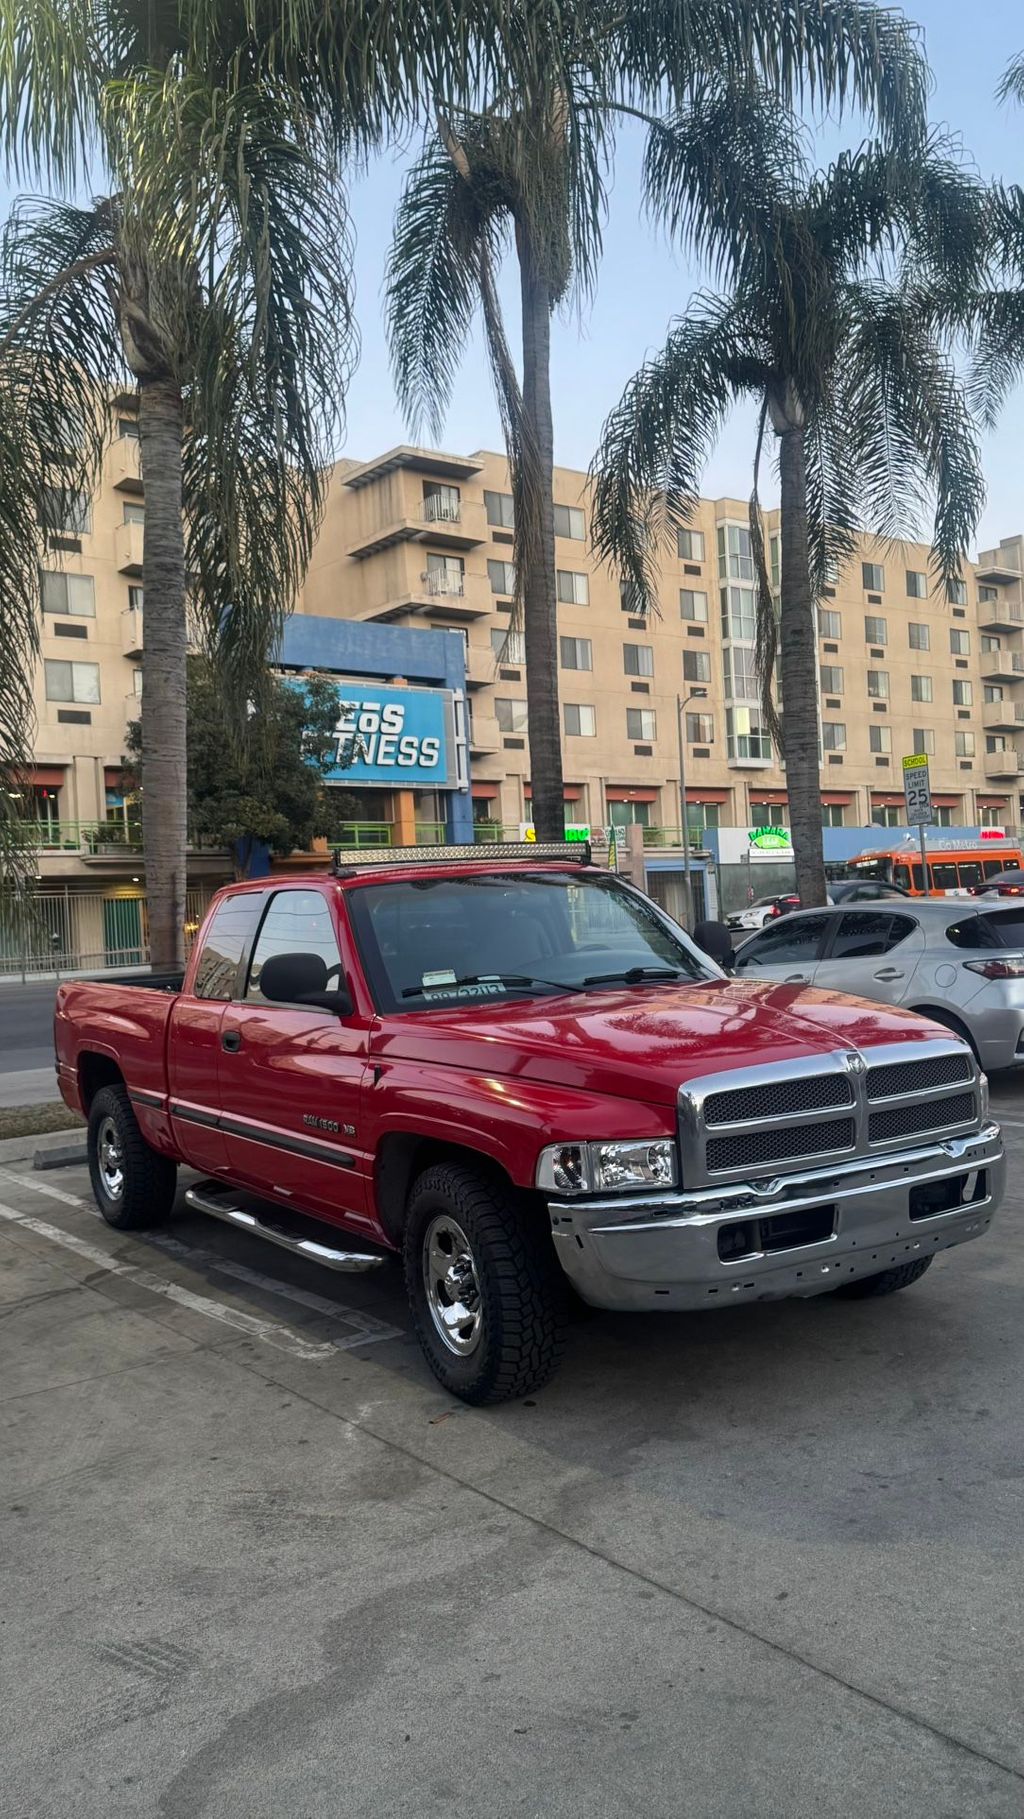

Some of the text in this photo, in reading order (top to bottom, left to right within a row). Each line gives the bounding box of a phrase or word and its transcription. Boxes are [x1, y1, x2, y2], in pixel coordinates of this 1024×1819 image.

[301, 731, 440, 767] TNESS
[904, 757, 926, 767] SCHOOL
[906, 770, 927, 780] SPEED
[908, 779, 925, 789] LIMIT
[908, 789, 928, 806] 25
[303, 1115, 318, 1127] RAM
[319, 1119, 339, 1132] 1500
